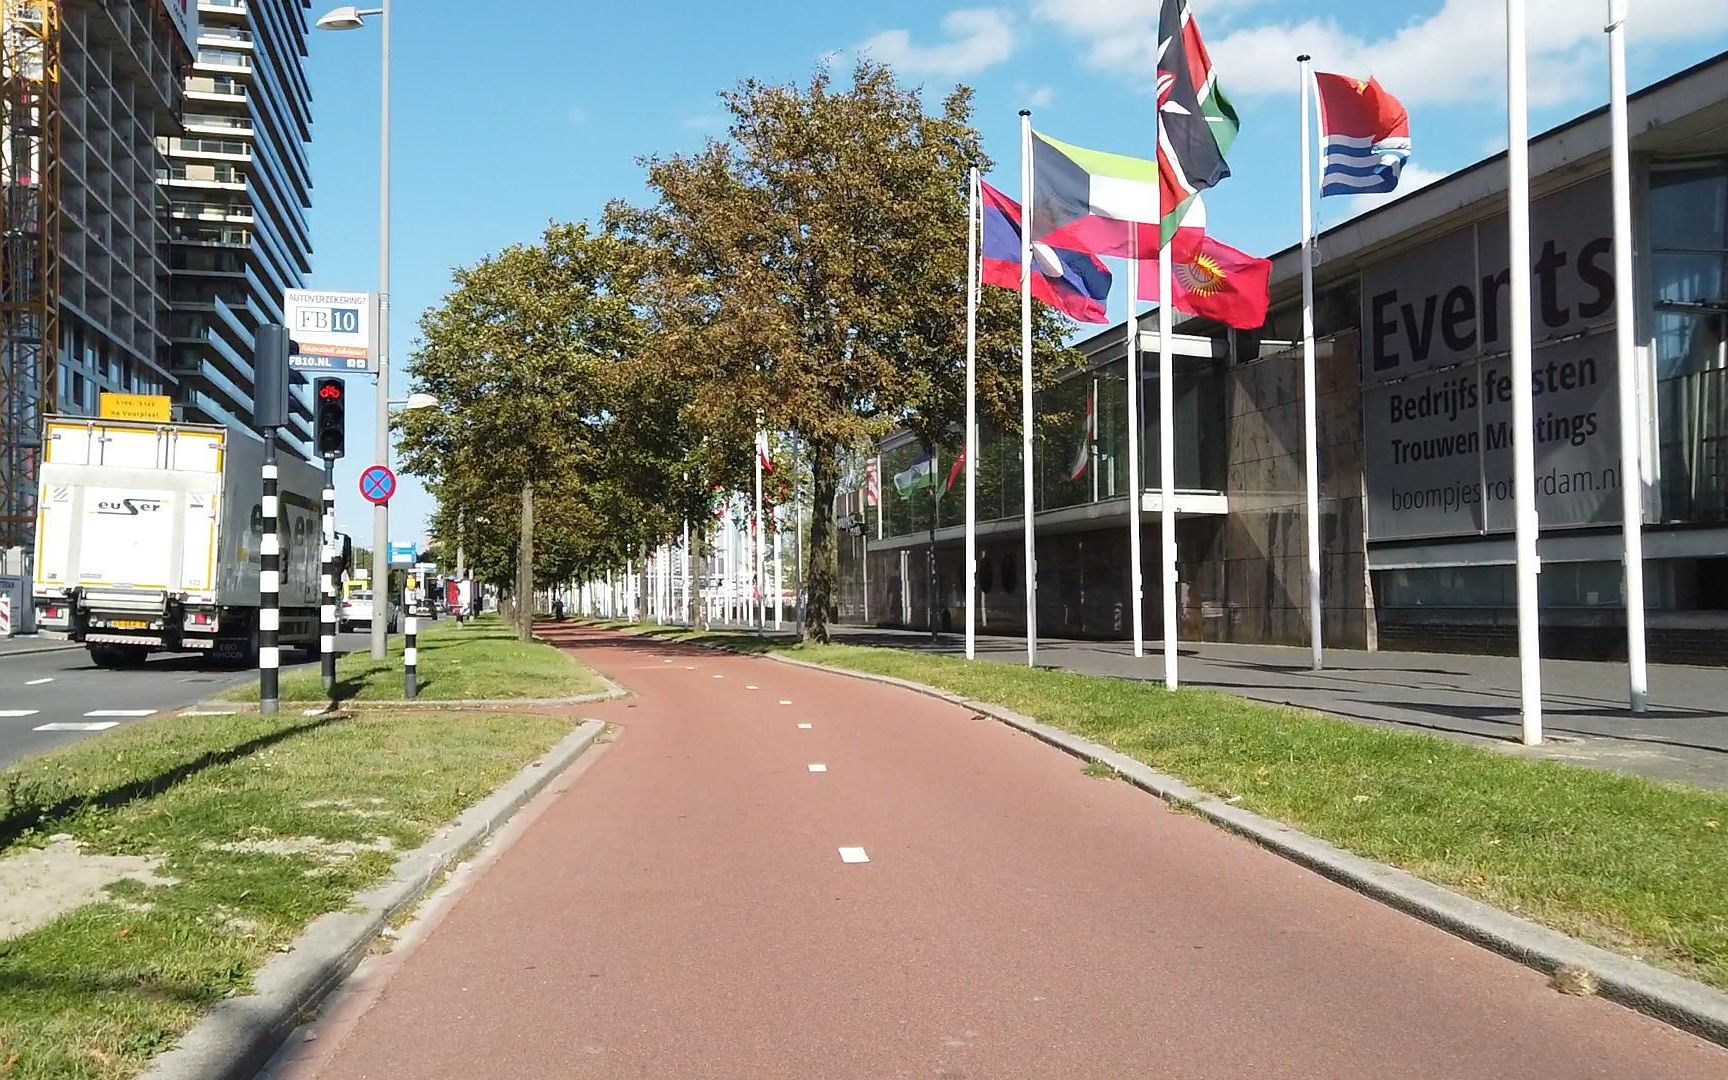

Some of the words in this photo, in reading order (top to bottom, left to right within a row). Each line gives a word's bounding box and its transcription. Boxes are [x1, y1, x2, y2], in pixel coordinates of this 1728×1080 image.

[288, 356, 332, 367] FB10.NL
[1392, 431, 1479, 465] Trouwen
[1487, 411, 1598, 450] Mtings
